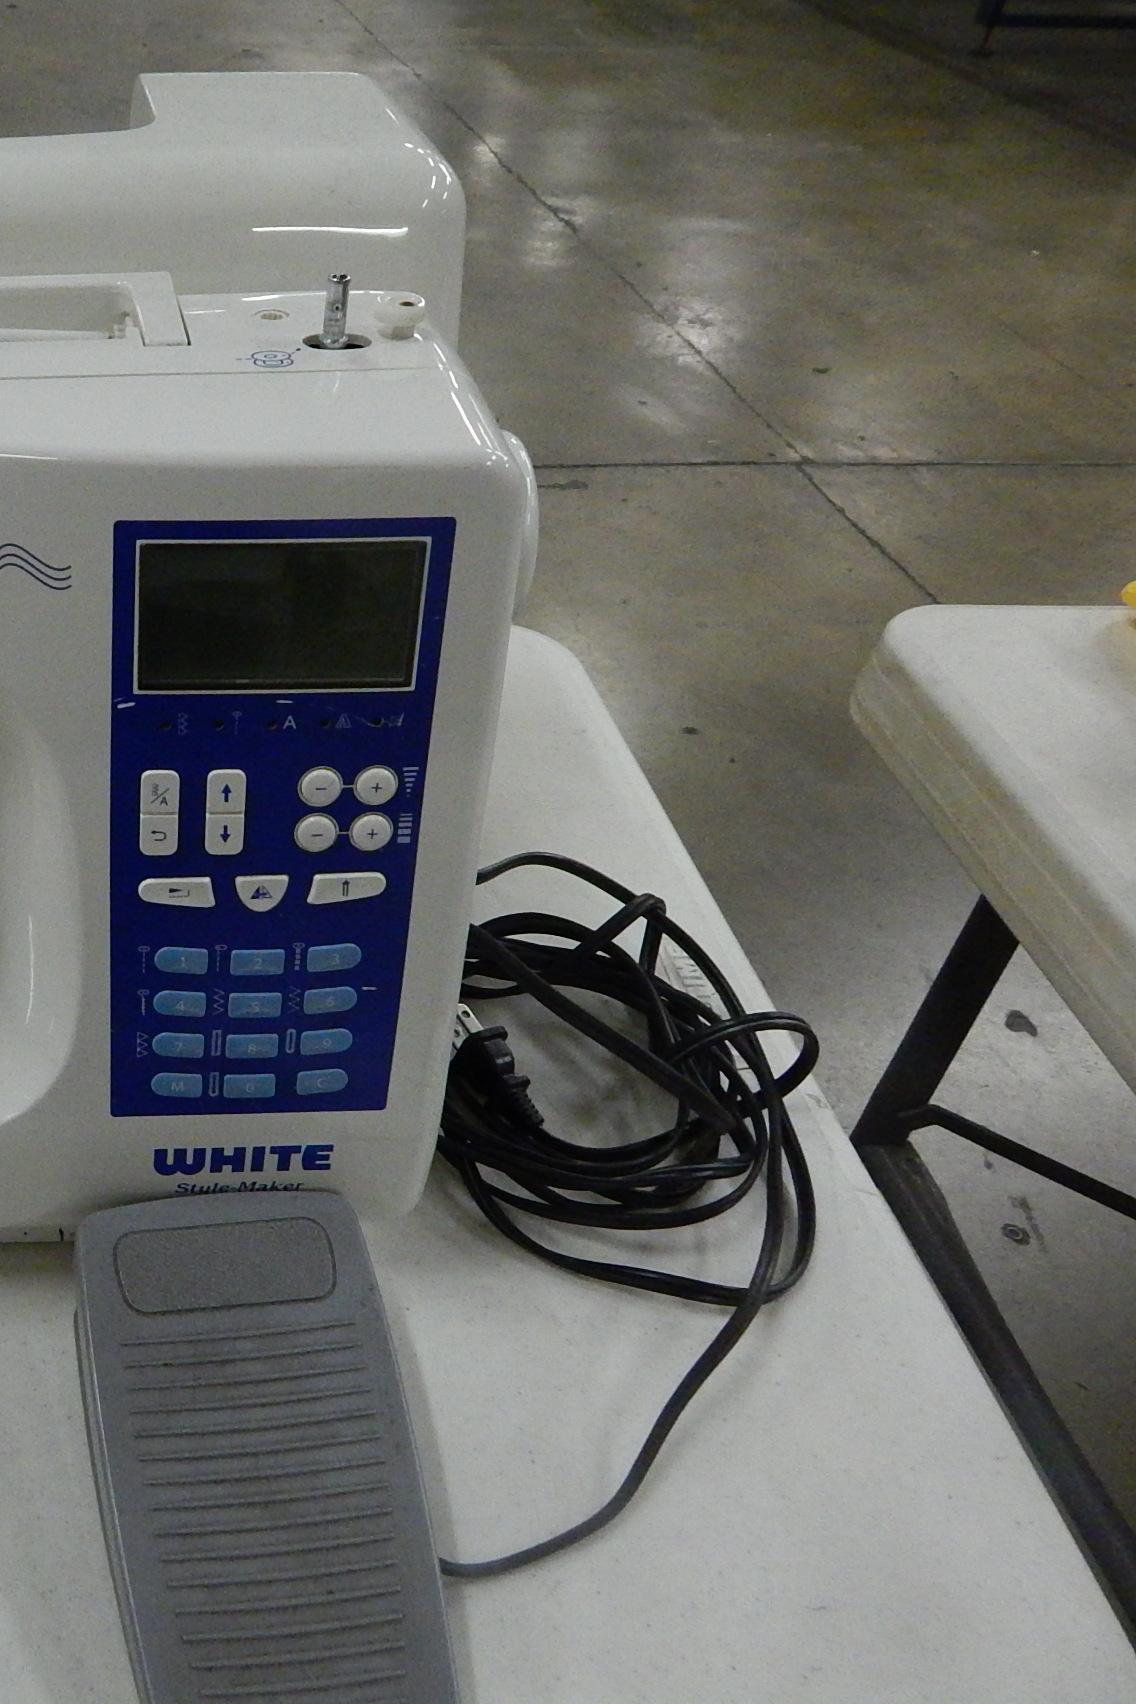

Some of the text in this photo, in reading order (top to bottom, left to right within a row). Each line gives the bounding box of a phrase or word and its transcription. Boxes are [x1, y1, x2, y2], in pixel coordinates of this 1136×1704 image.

[283, 715, 297, 729] A
[179, 956, 186, 968] 1
[254, 957, 263, 970] 2
[332, 953, 340, 965] 3
[175, 1000, 185, 1011] 4
[250, 1002, 260, 1012] 5
[326, 996, 335, 1007] 6
[174, 1042, 183, 1053] 7
[247, 1044, 257, 1054] 8
[323, 1038, 332, 1049] 9
[171, 1081, 184, 1092] M
[317, 1078, 327, 1088] C
[153, 1144, 335, 1177] WHITE
[175, 1181, 305, 1194] Style-Maker
